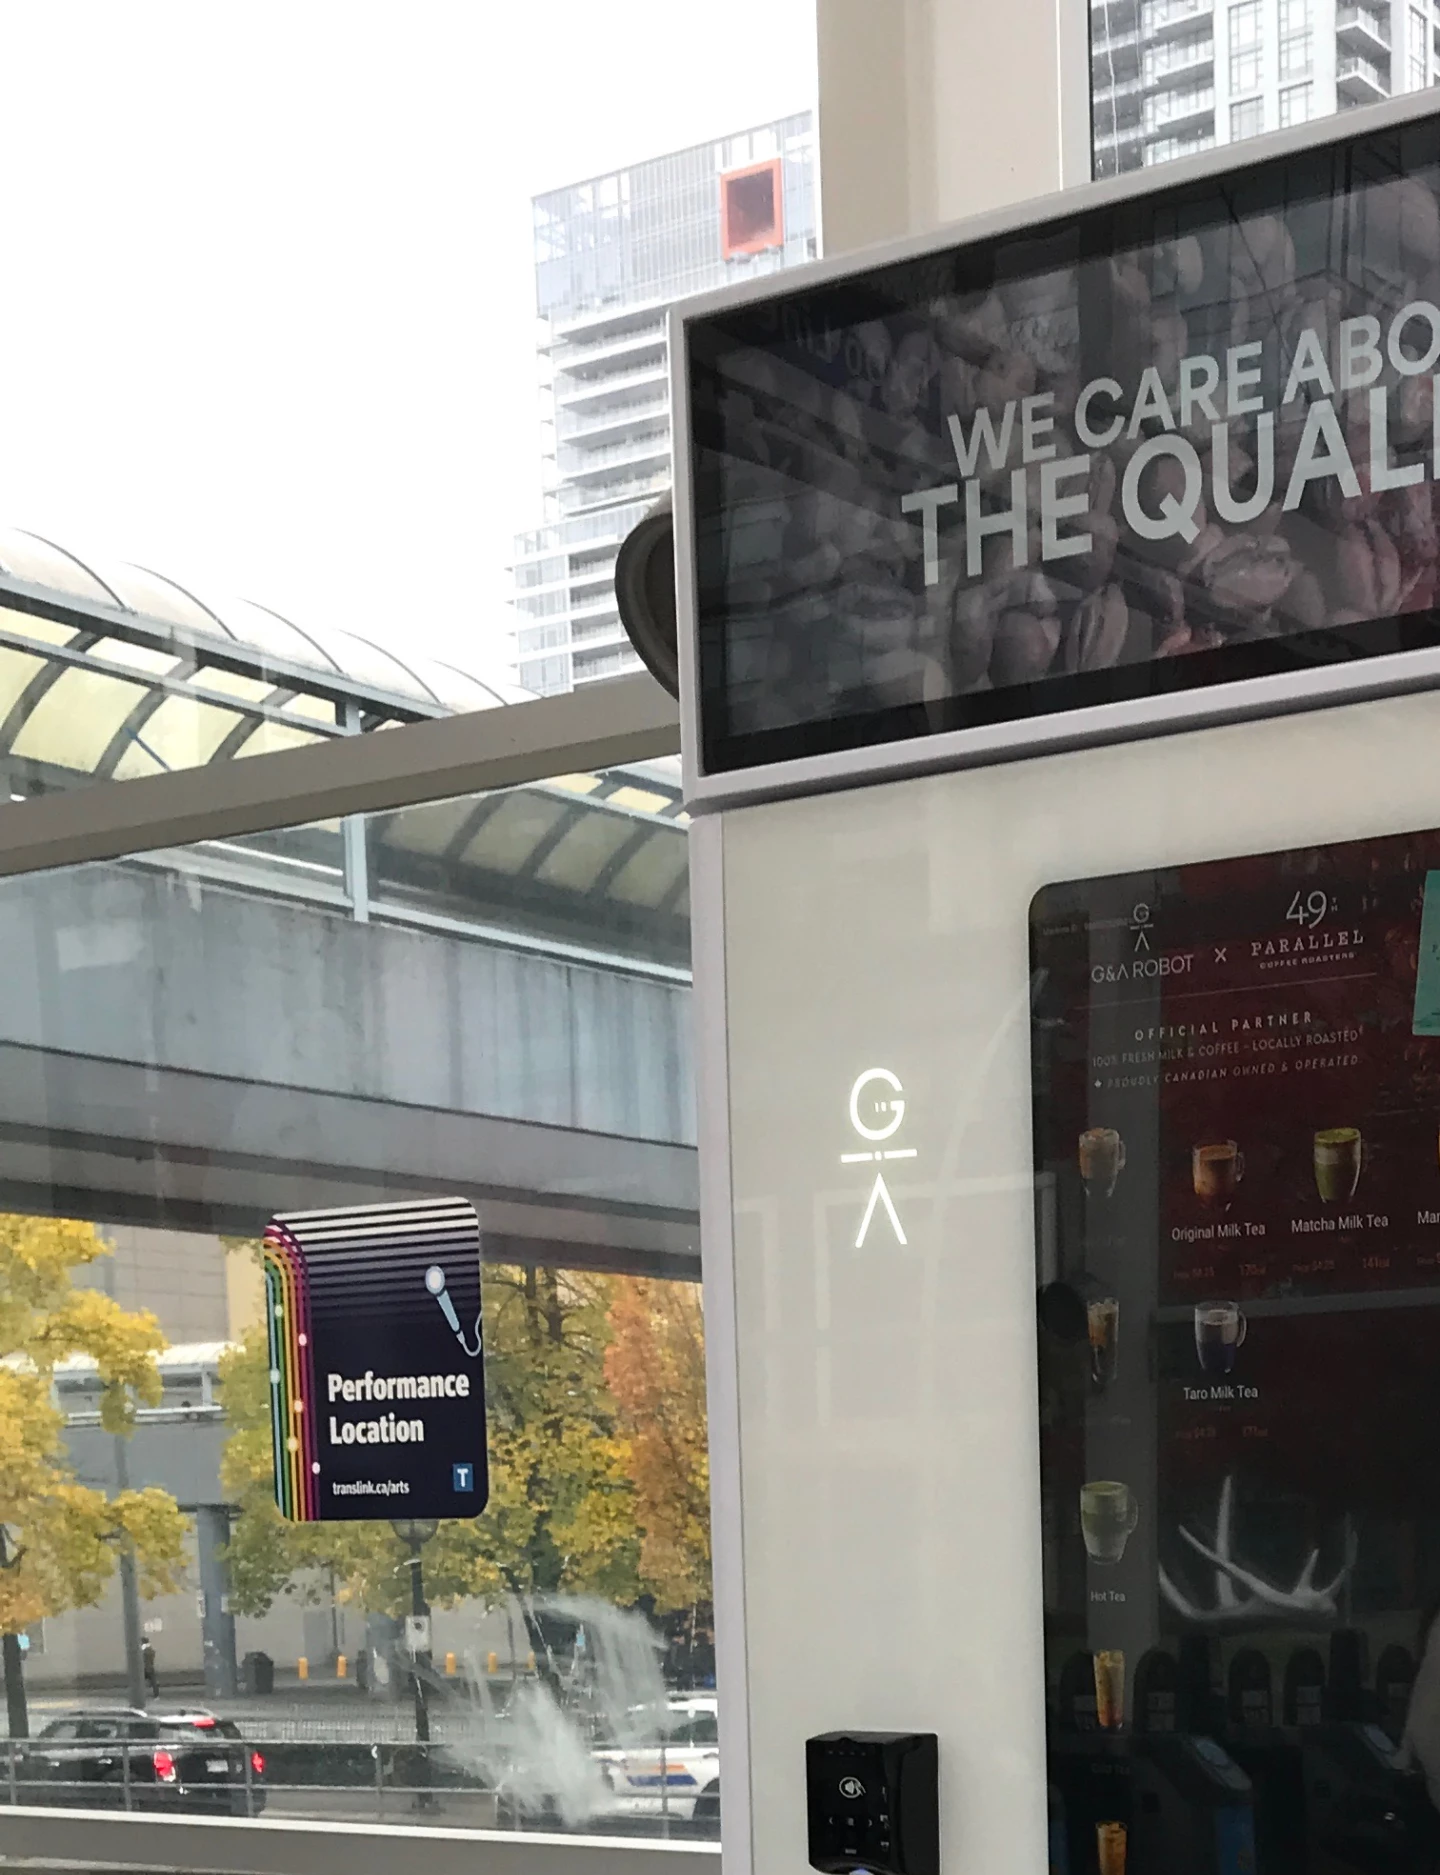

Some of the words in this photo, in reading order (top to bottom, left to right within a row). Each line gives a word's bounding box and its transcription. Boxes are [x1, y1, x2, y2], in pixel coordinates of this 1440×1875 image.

[947, 392, 1058, 478] WE
[1074, 340, 1265, 449] CARE
[901, 454, 1094, 587] THE
[1285, 890, 1328, 929] 49
[1251, 929, 1364, 957] PARALLEL
[1132, 953, 1195, 979] ROBOT
[1260, 958, 1299, 970] COFFEE
[1301, 951, 1355, 965] ROASTERS
[1134, 1021, 1219, 1041] OFFICIAL
[1232, 1011, 1313, 1032] PARTNER
[1122, 1050, 1155, 1064] FRESH
[1158, 1047, 1183, 1060] MILK
[1198, 1040, 1240, 1057] COFFEE
[1252, 1035, 1301, 1052] LOCALLY
[1306, 1029, 1358, 1045] ROASTED
[1107, 1074, 1159, 1088] PROUDLY
[1164, 1067, 1227, 1083] CANADIAN
[1232, 1063, 1275, 1078] OWNED
[1295, 1055, 1358, 1071] OPERATED
[1171, 1224, 1214, 1243] Original
[1217, 1223, 1241, 1238] Milk
[1244, 1222, 1266, 1236] Tea
[1291, 1217, 1335, 1234] Matcha
[1338, 1214, 1363, 1230] Milk
[1366, 1213, 1389, 1228] Tea
[327, 1370, 470, 1402] Performance
[1183, 1386, 1208, 1400] Taro
[1210, 1385, 1235, 1399] Milk
[1237, 1384, 1259, 1398] Tea
[329, 1412, 425, 1445] Location
[332, 1480, 410, 1496] translink.ca/arts
[456, 1468, 469, 1488] T
[1090, 1590, 1107, 1602] Hot
[1109, 1590, 1126, 1602] Tea
